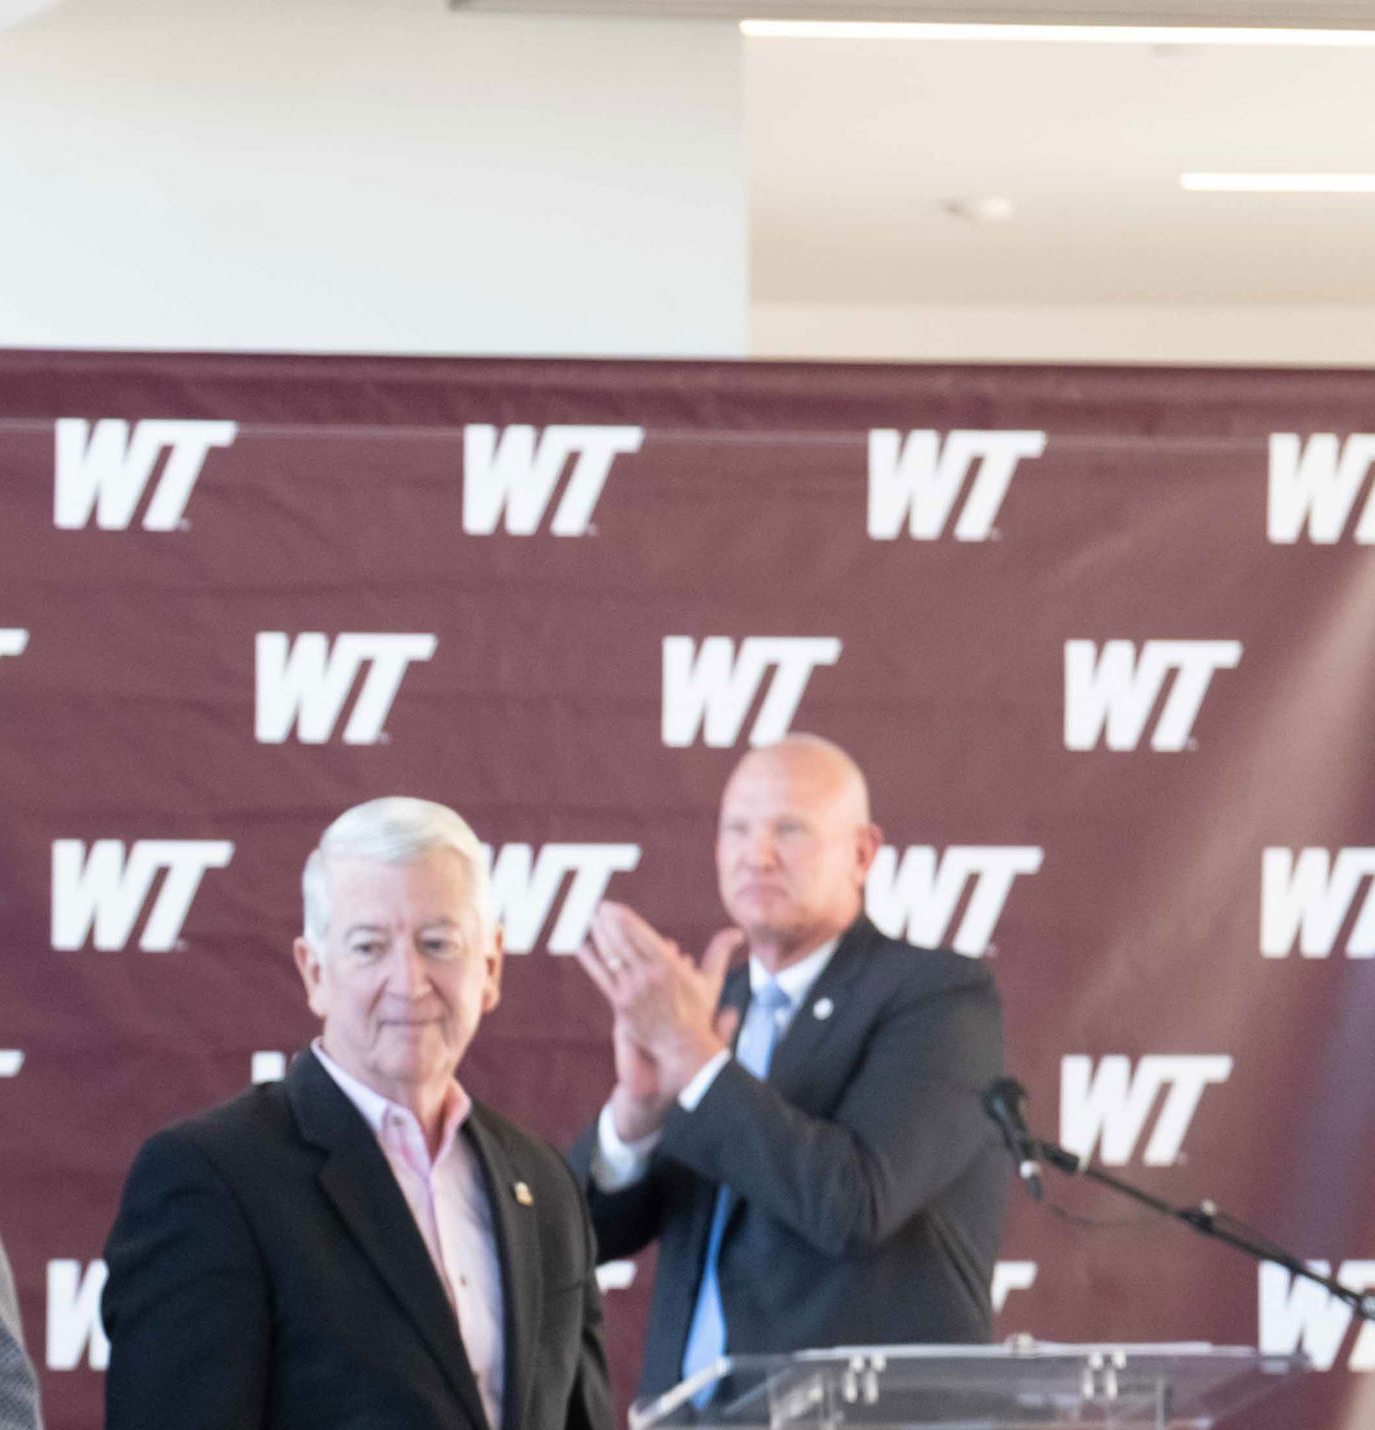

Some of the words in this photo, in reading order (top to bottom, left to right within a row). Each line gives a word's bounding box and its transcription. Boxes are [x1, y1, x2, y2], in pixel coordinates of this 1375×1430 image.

[53, 417, 238, 531] WT
[462, 423, 645, 537] WT
[867, 428, 1047, 542] WT
[1267, 432, 1375, 545] W
[255, 631, 437, 745] WT
[661, 635, 842, 748] WT
[1063, 639, 1243, 752] WT
[51, 838, 234, 952] WT
[862, 844, 1043, 957] WT
[1059, 1054, 1234, 1167] WT
